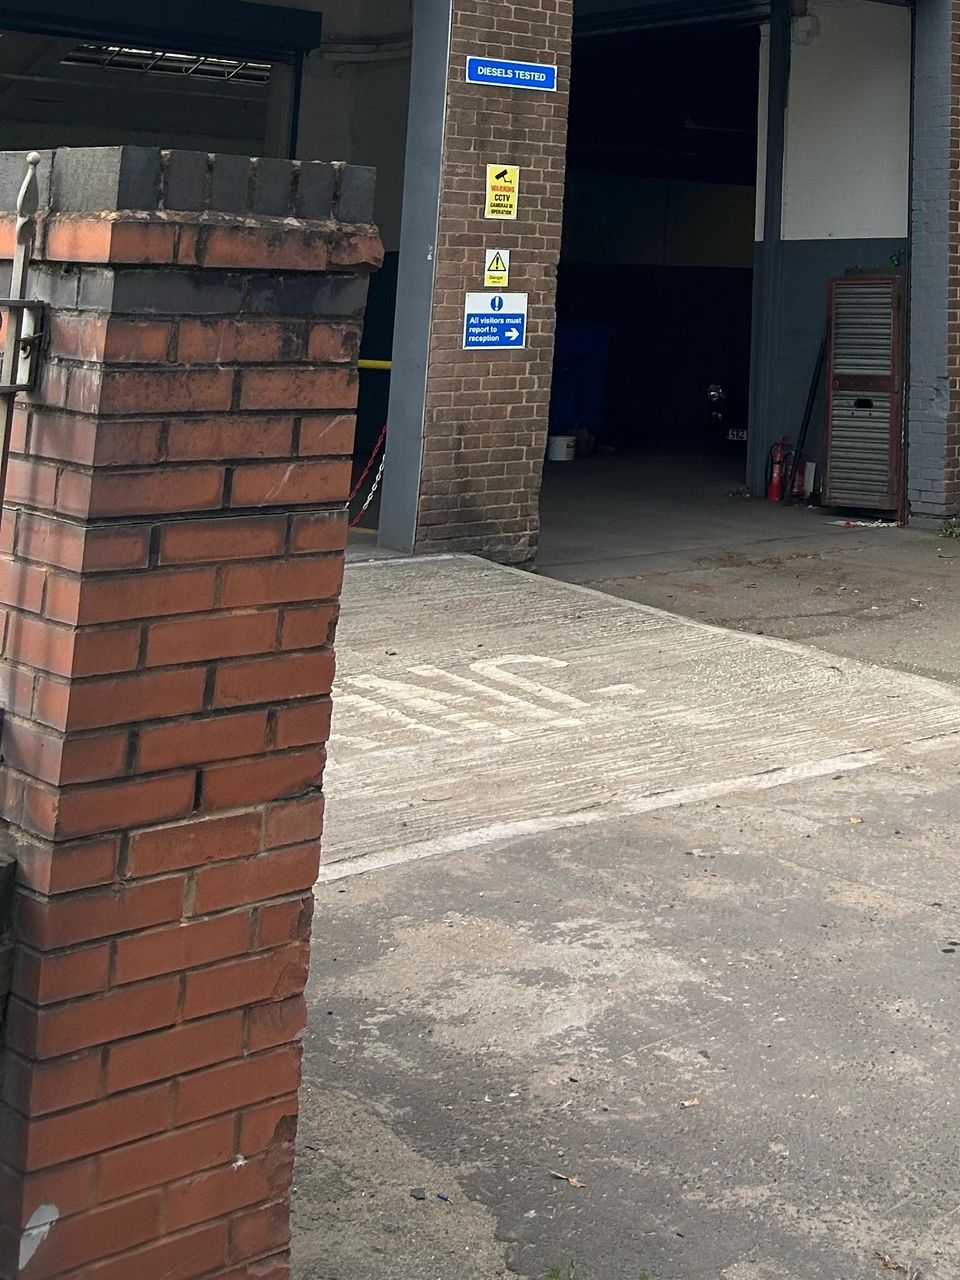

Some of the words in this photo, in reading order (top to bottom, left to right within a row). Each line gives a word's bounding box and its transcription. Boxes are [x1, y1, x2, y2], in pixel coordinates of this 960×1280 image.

[477, 66, 513, 78] DIESELS
[514, 70, 546, 81] TESTED
[494, 194, 511, 202] CCTV
[469, 326, 489, 334] report
[468, 335, 500, 343] reception
